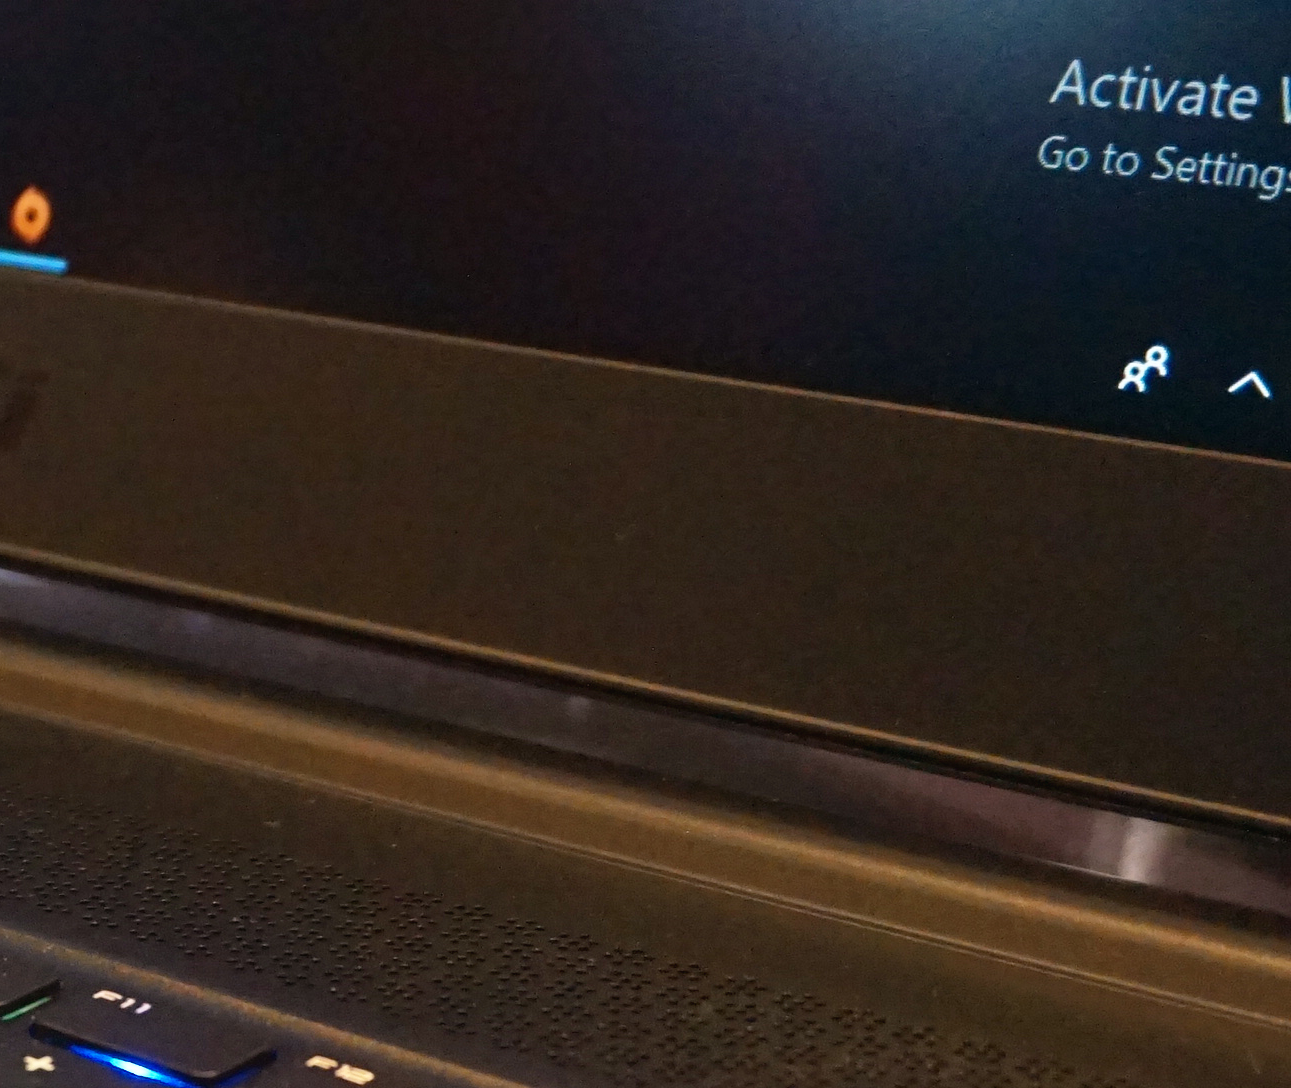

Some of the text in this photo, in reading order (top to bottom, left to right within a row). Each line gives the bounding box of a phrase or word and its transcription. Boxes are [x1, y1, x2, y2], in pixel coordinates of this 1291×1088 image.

[1049, 58, 1261, 121] Activate
[1038, 136, 1090, 171] Go
[1103, 144, 1140, 176] to
[91, 988, 153, 1016] F11
